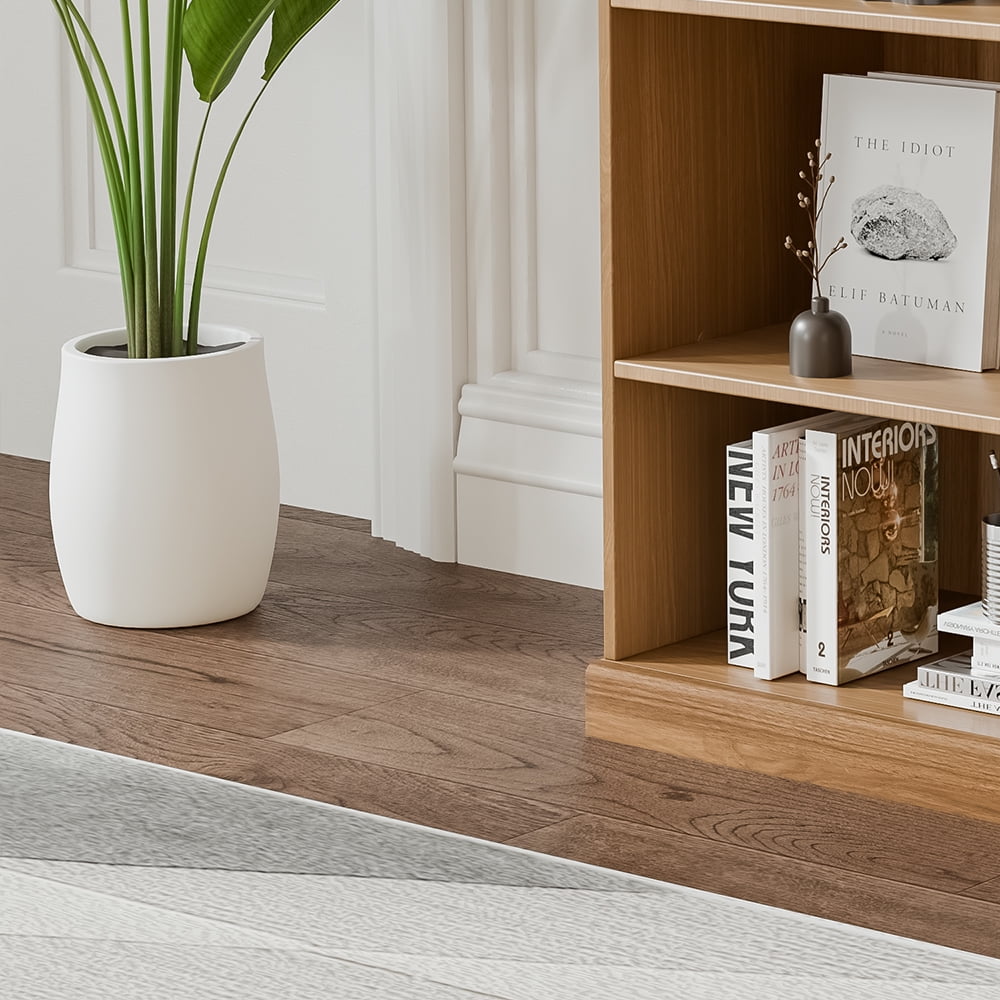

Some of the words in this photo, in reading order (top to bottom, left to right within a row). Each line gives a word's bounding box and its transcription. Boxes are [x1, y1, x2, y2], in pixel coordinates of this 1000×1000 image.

[854, 136, 890, 151] THE
[901, 140, 956, 158] IDIOT
[829, 285, 868, 301] ELIF
[879, 291, 966, 314] BATUMAN
[842, 421, 937, 469] INTERIORS
[772, 464, 787, 481] IN
[820, 476, 831, 555] INTERIORS
[818, 642, 826, 658] 2
[887, 631, 894, 647] 2
